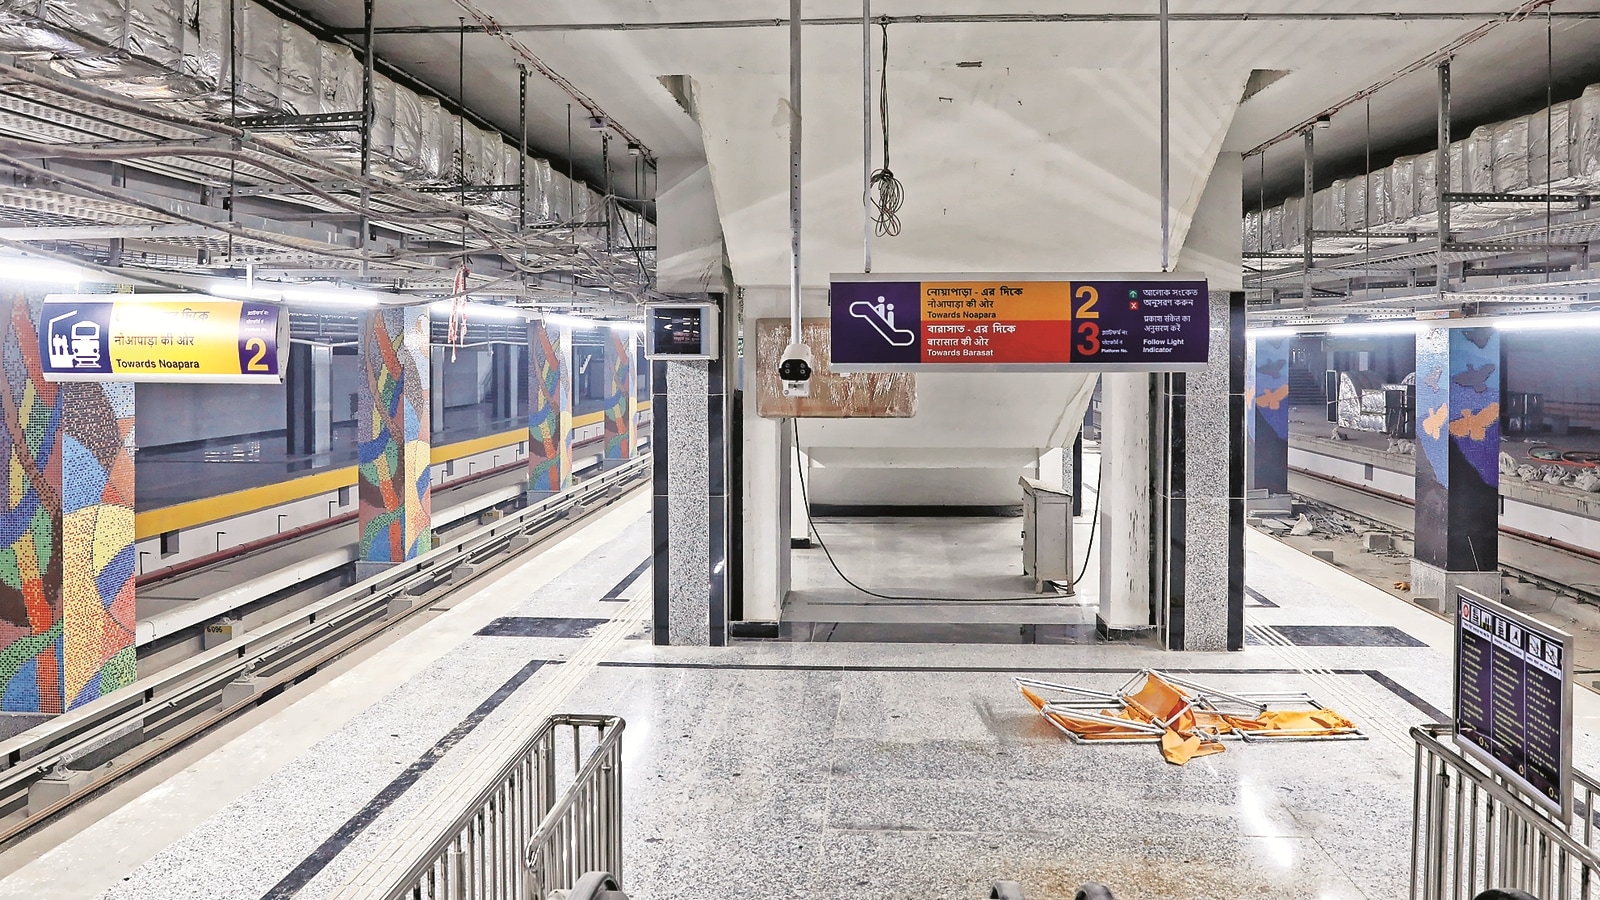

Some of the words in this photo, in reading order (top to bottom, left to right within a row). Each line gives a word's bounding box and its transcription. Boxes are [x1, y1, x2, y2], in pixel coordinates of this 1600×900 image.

[926, 288, 972, 298] নোয়াপাড়া
[981, 288, 995, 296] এর
[1000, 286, 1023, 297] দিকে
[927, 299, 964, 309] नोआपाड़ा
[966, 298, 977, 308] की
[979, 298, 994, 308] ओर
[1075, 285, 1100, 319] 2
[1143, 299, 1172, 308] অনুসরণ
[1174, 299, 1194, 307] করুন
[963, 311, 996, 319] Noapara
[927, 324, 965, 334] বারাসাত
[974, 324, 989, 334] এর
[992, 322, 1016, 334] দিকে
[1144, 325, 1169, 334] अनुसरण
[114, 333, 158, 349] नोआपाड़ा
[160, 333, 174, 346] की
[177, 333, 194, 346] ओर
[927, 338, 958, 346] बारासात
[960, 336, 972, 346] की
[974, 336, 990, 346] ओर
[1077, 321, 1101, 356] 3
[1167, 338, 1184, 347] Light
[245, 337, 269, 371] 2
[116, 358, 157, 369] Towards
[159, 358, 200, 371] Noapara
